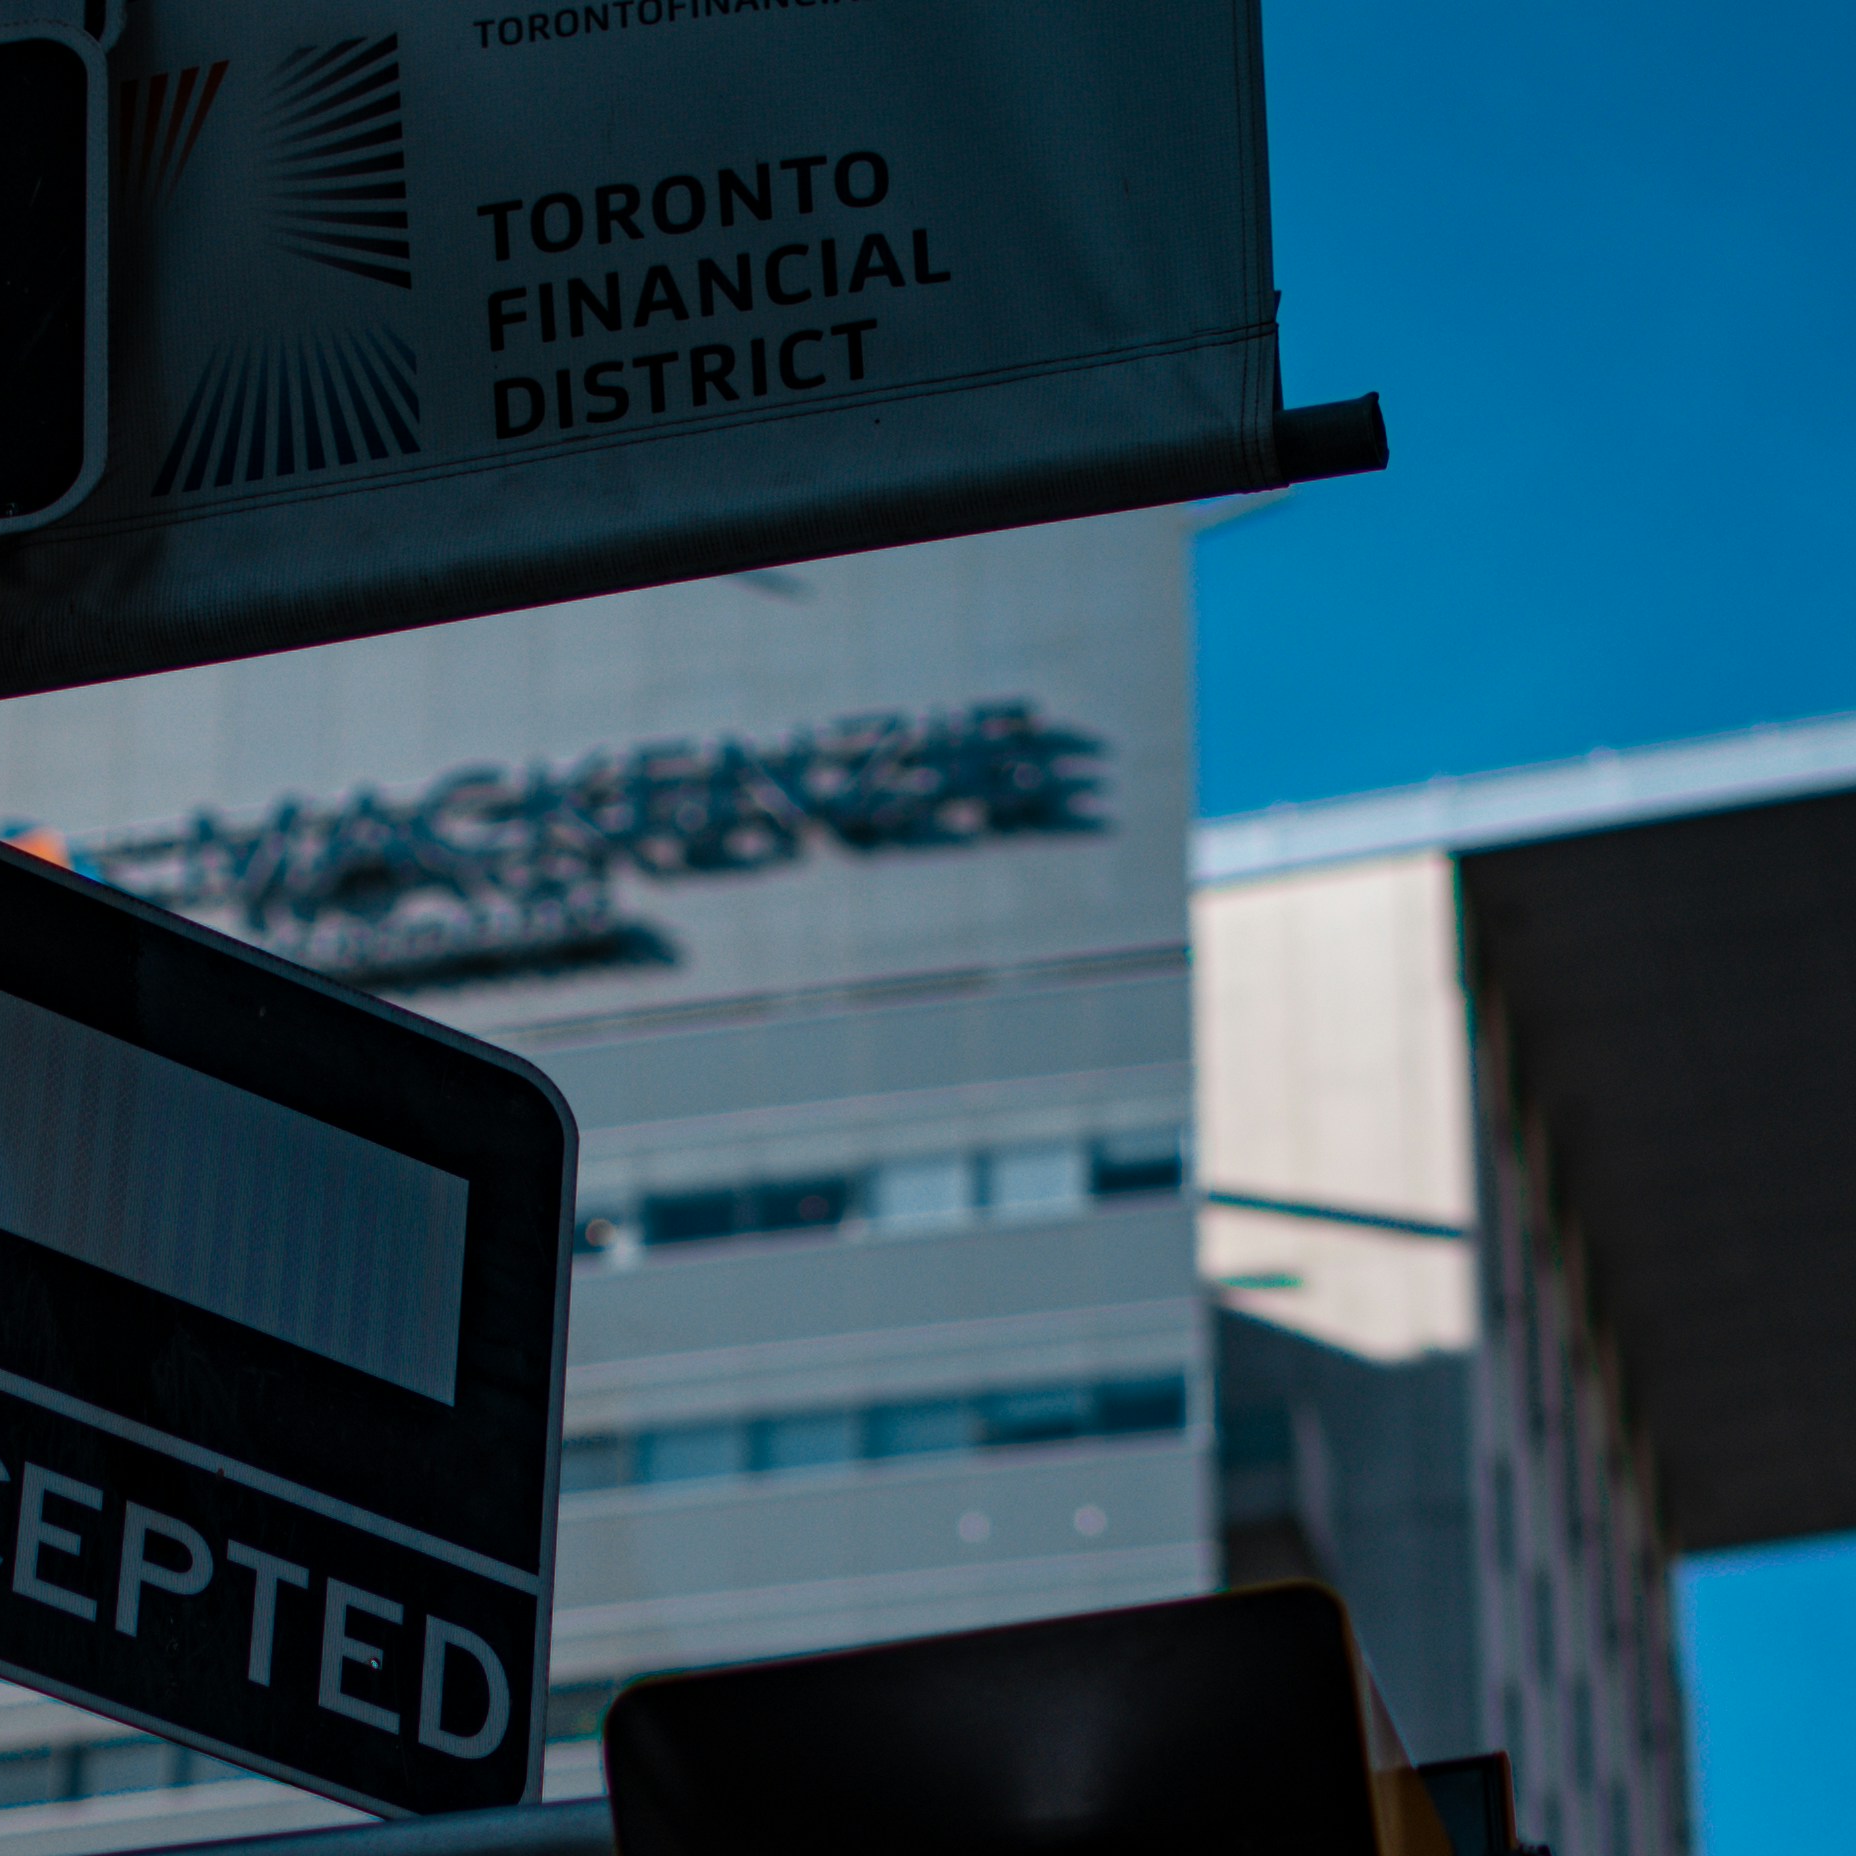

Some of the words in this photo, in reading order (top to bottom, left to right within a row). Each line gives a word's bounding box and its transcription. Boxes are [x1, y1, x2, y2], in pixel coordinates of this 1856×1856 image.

[476, 150, 890, 262] TORONTO
[487, 228, 951, 352] FINANCIAL
[493, 318, 878, 440] DISTRICT
